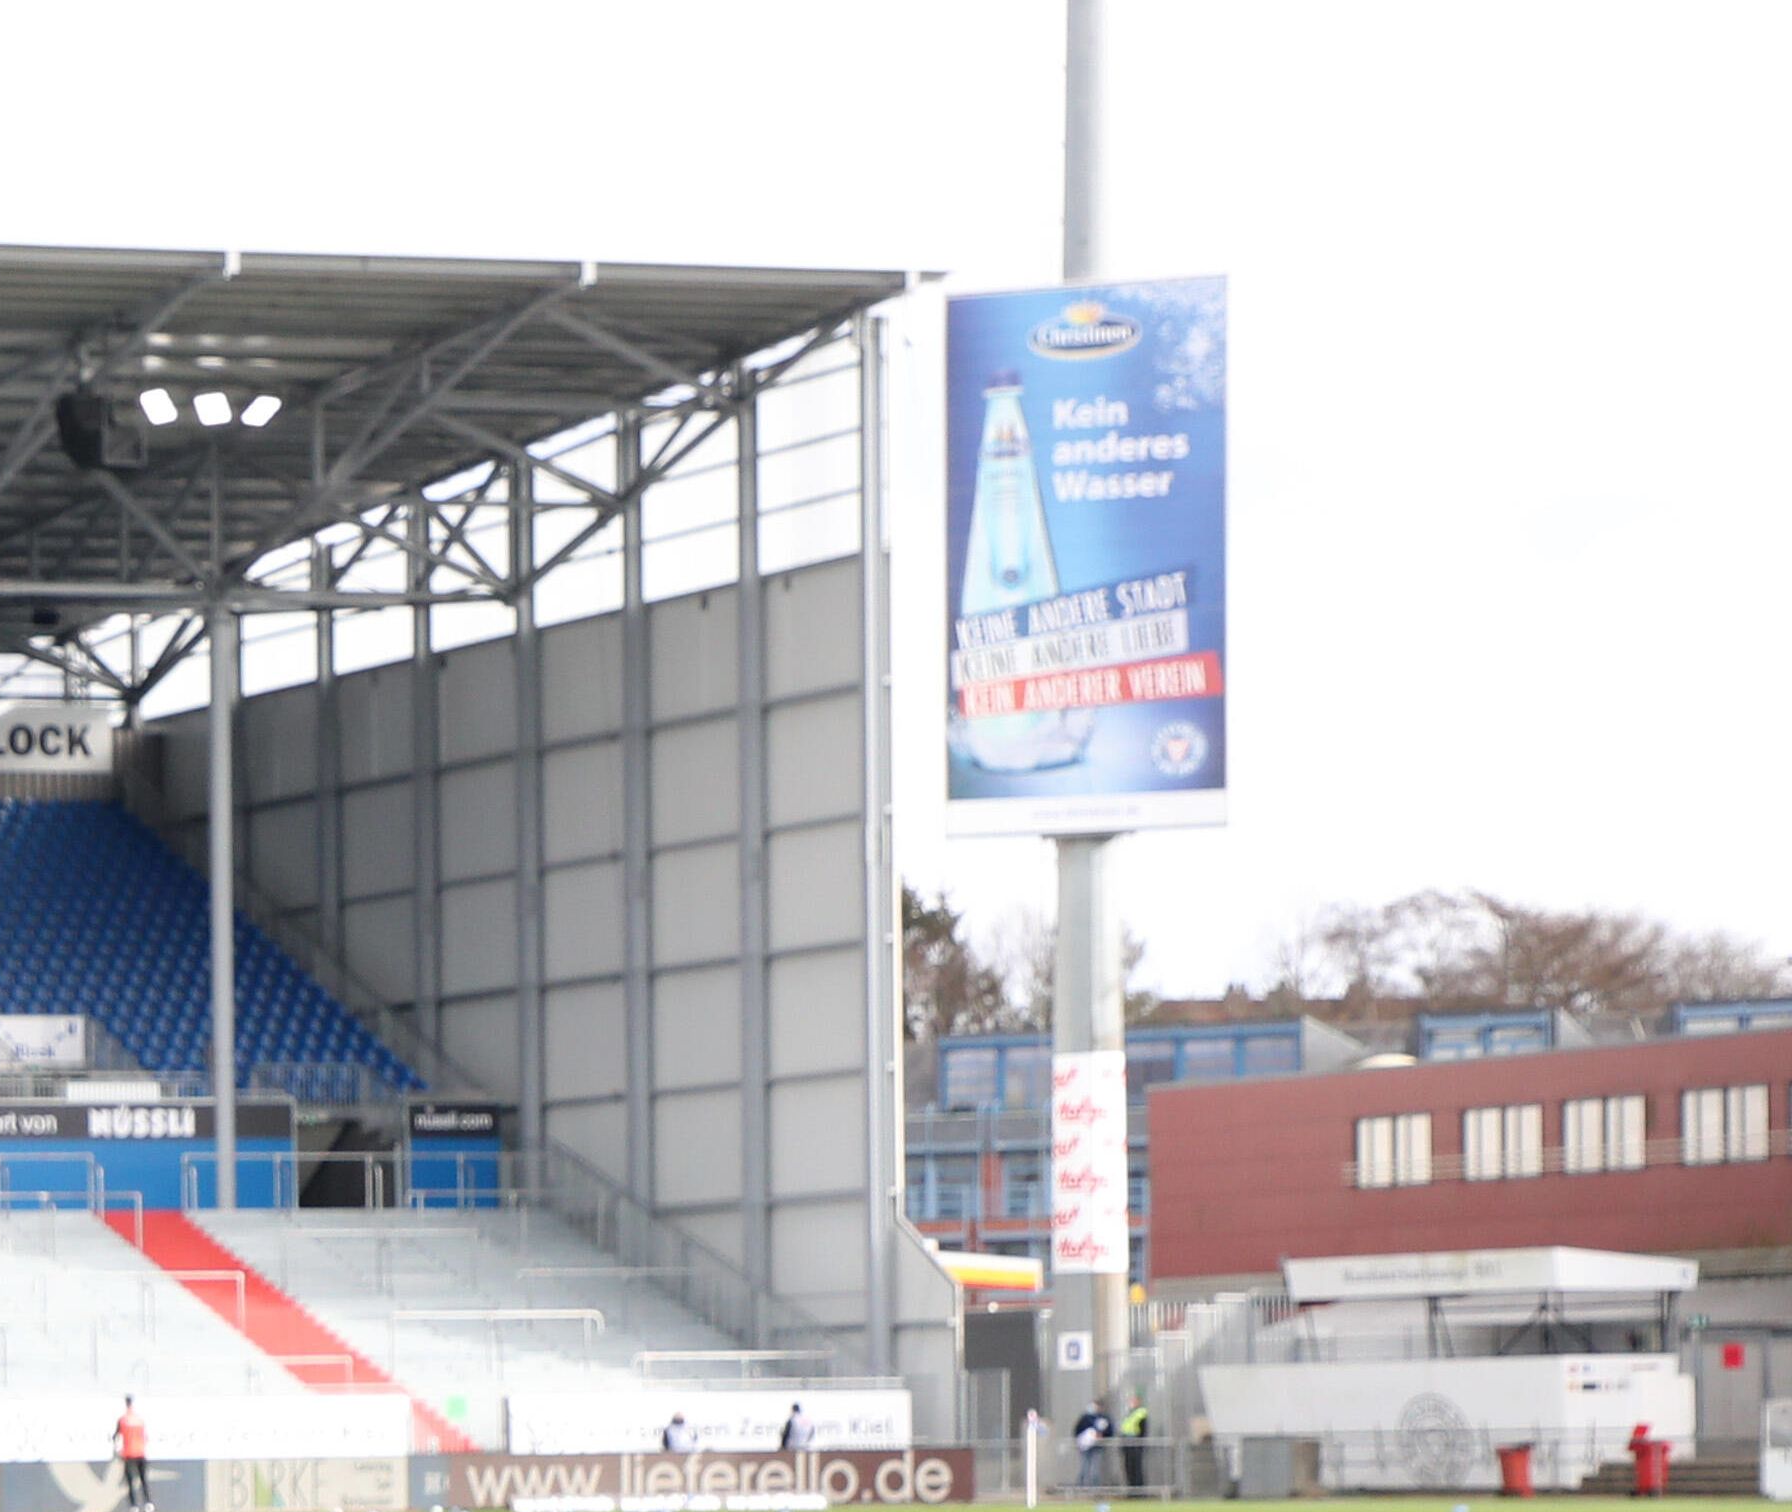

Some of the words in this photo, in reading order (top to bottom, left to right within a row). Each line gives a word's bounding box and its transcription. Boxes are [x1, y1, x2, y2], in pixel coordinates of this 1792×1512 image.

[1052, 396, 1129, 429] Kein
[1052, 431, 1190, 466] anderes
[1052, 469, 1174, 501] Wasser
[1116, 571, 1187, 619] STADT
[22, 1115, 58, 1136] von
[466, 1449, 954, 1508] www.lieferello.de
